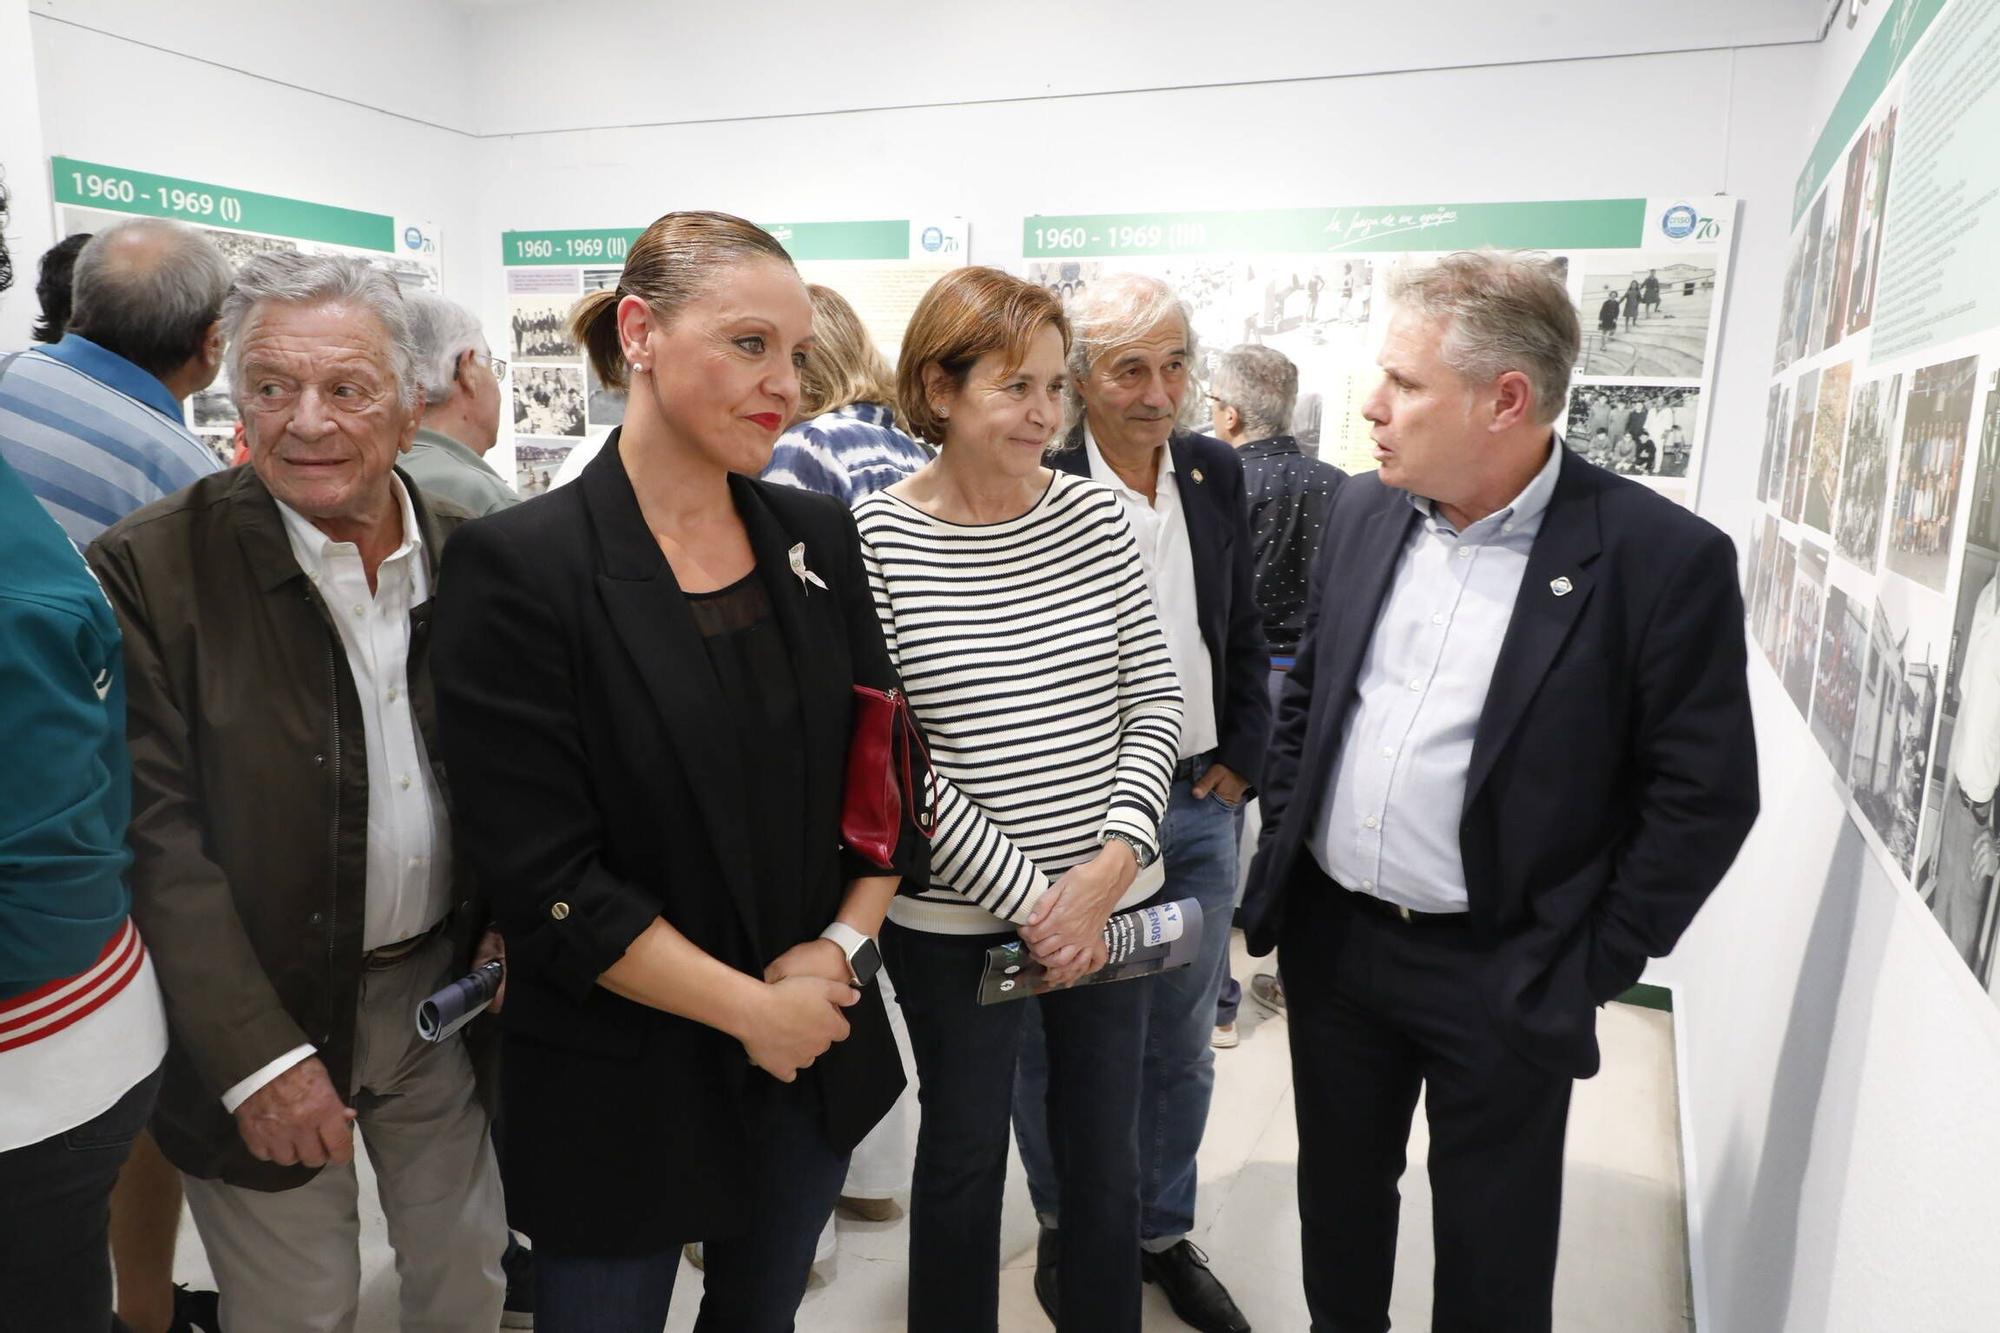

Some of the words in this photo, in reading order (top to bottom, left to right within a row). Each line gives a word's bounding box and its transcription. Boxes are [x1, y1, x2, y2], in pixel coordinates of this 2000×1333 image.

[72, 172, 134, 203] 1960
[157, 187, 214, 215] 1969
[219, 196, 242, 223] (I)
[1034, 227, 1087, 249] 1960
[1108, 225, 1162, 248] 1969
[1696, 217, 1721, 240] 70
[516, 240, 552, 258] 1960
[566, 238, 603, 257] 1969
[606, 236, 628, 259] (II)
